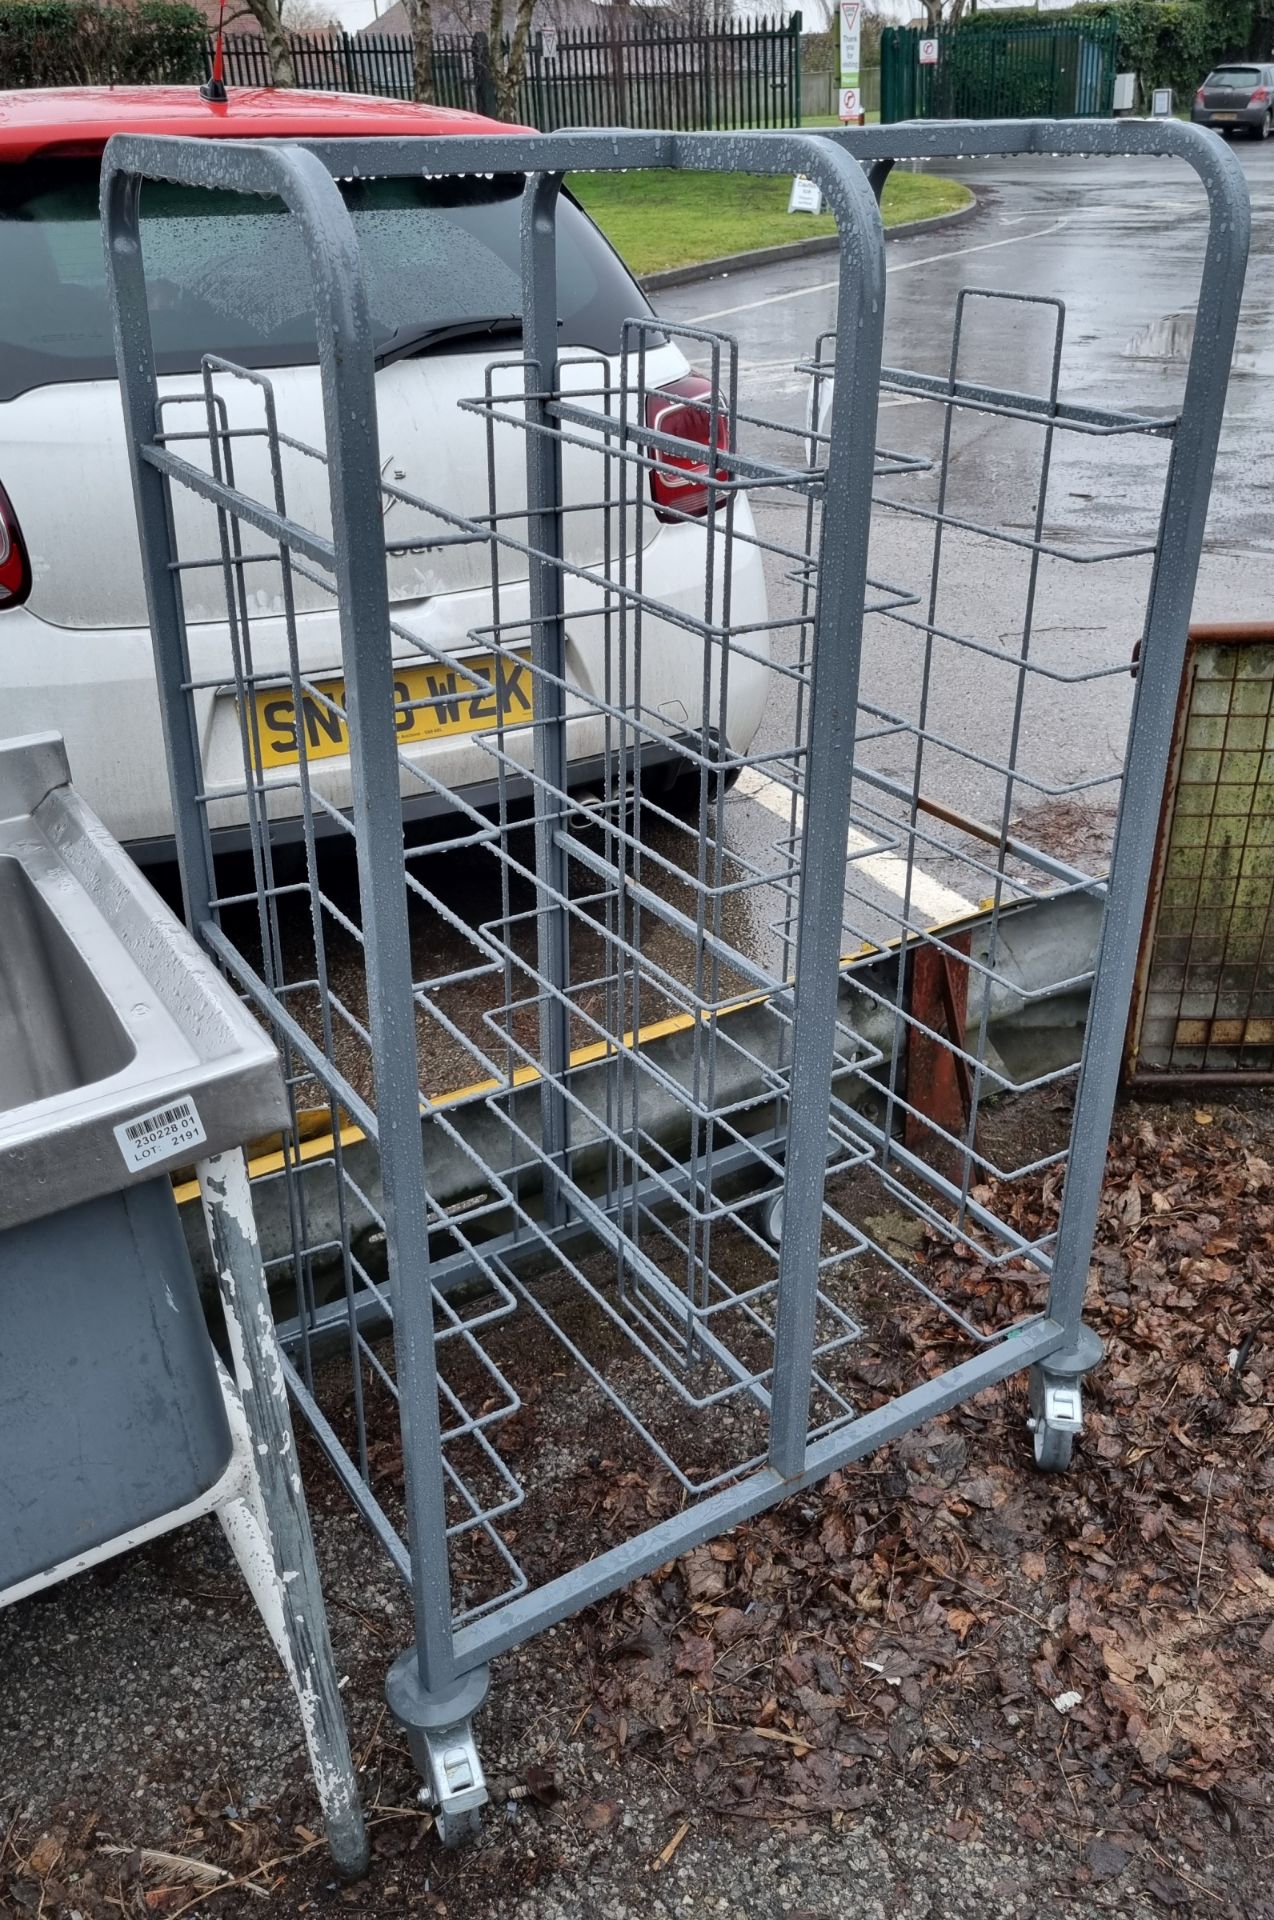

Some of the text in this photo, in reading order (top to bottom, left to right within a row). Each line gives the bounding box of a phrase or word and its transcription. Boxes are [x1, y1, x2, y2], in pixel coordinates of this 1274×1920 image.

[426, 664, 531, 725] WZK
[134, 1128, 200, 1162] LOT: 2191
[135, 1116, 195, 1148] 230228 01
